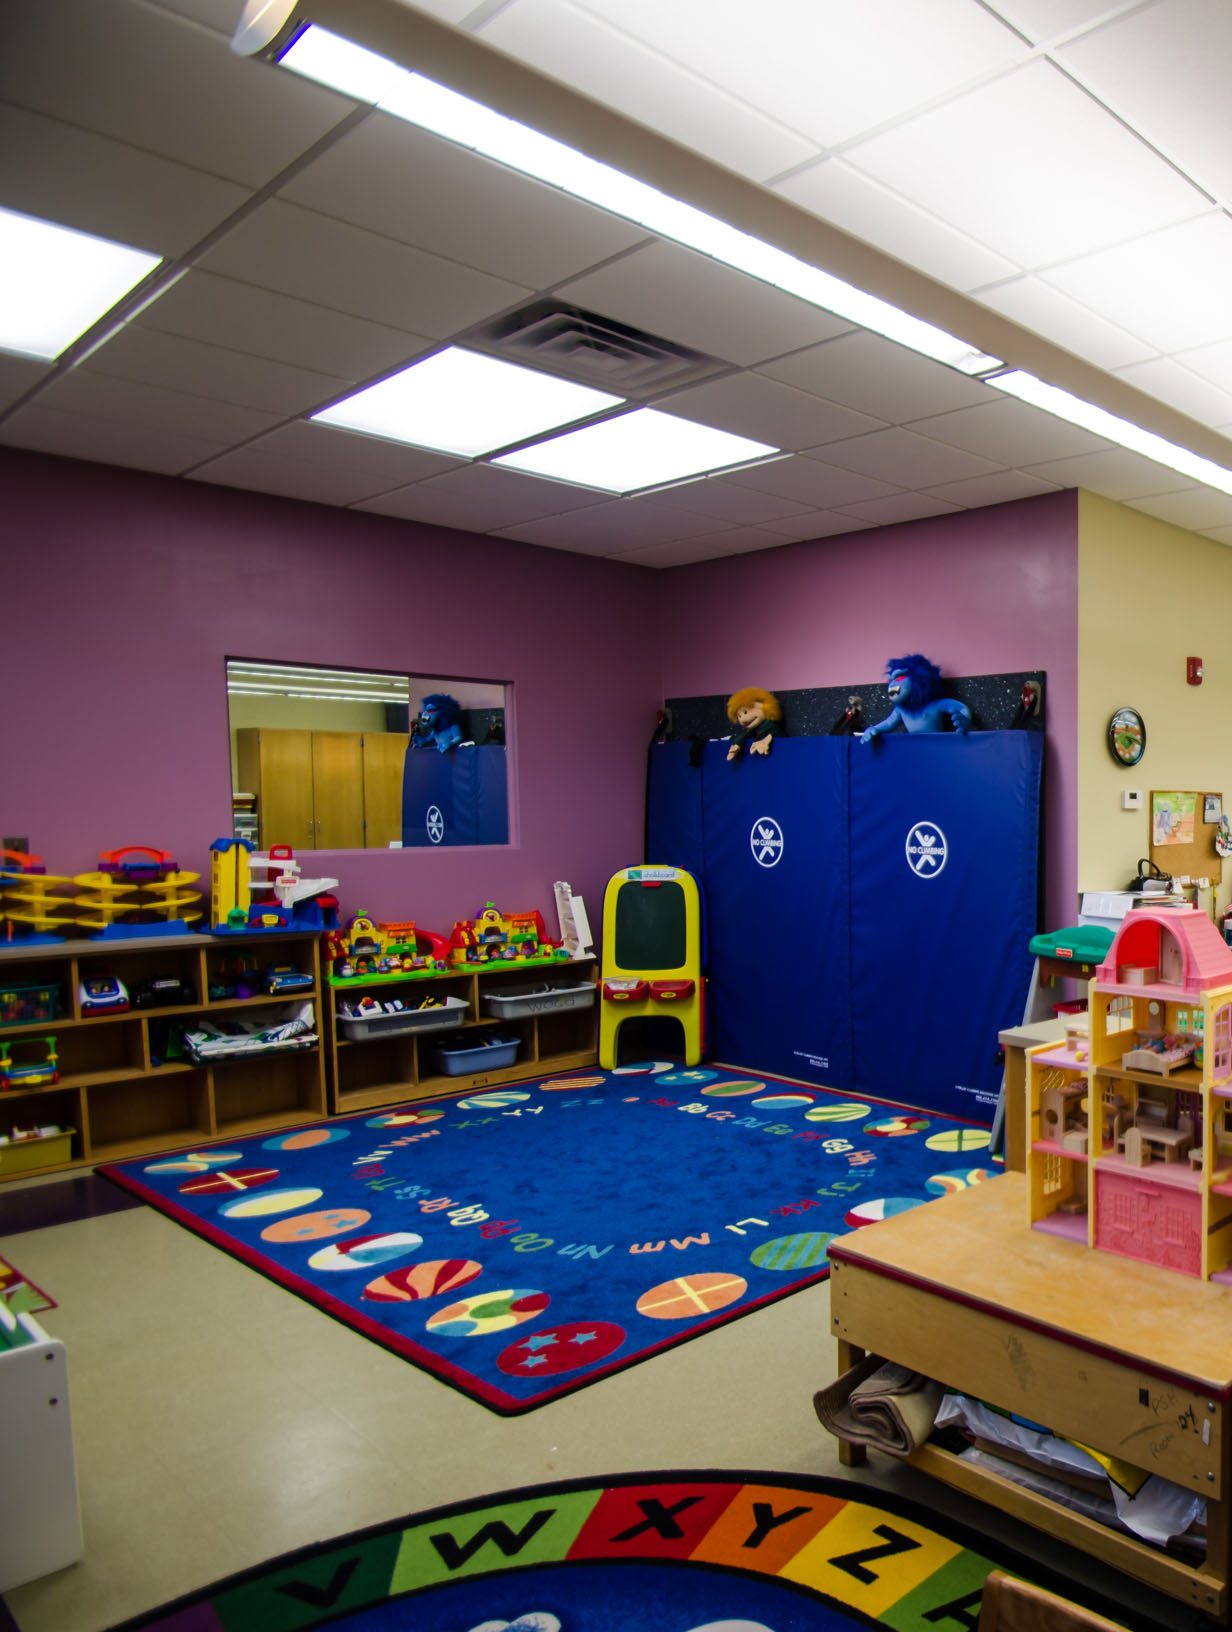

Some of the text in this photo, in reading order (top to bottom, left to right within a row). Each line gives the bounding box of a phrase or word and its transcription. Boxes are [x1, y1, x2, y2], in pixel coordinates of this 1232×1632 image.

[752, 838, 782, 847] NO CLIMBING
[908, 846, 944, 855] NO CLIMBING
[274, 1557, 361, 1609] V
[429, 1509, 557, 1571] W
[608, 1496, 706, 1542] X
[742, 1503, 813, 1548] Y
[827, 1524, 922, 1585] Z
